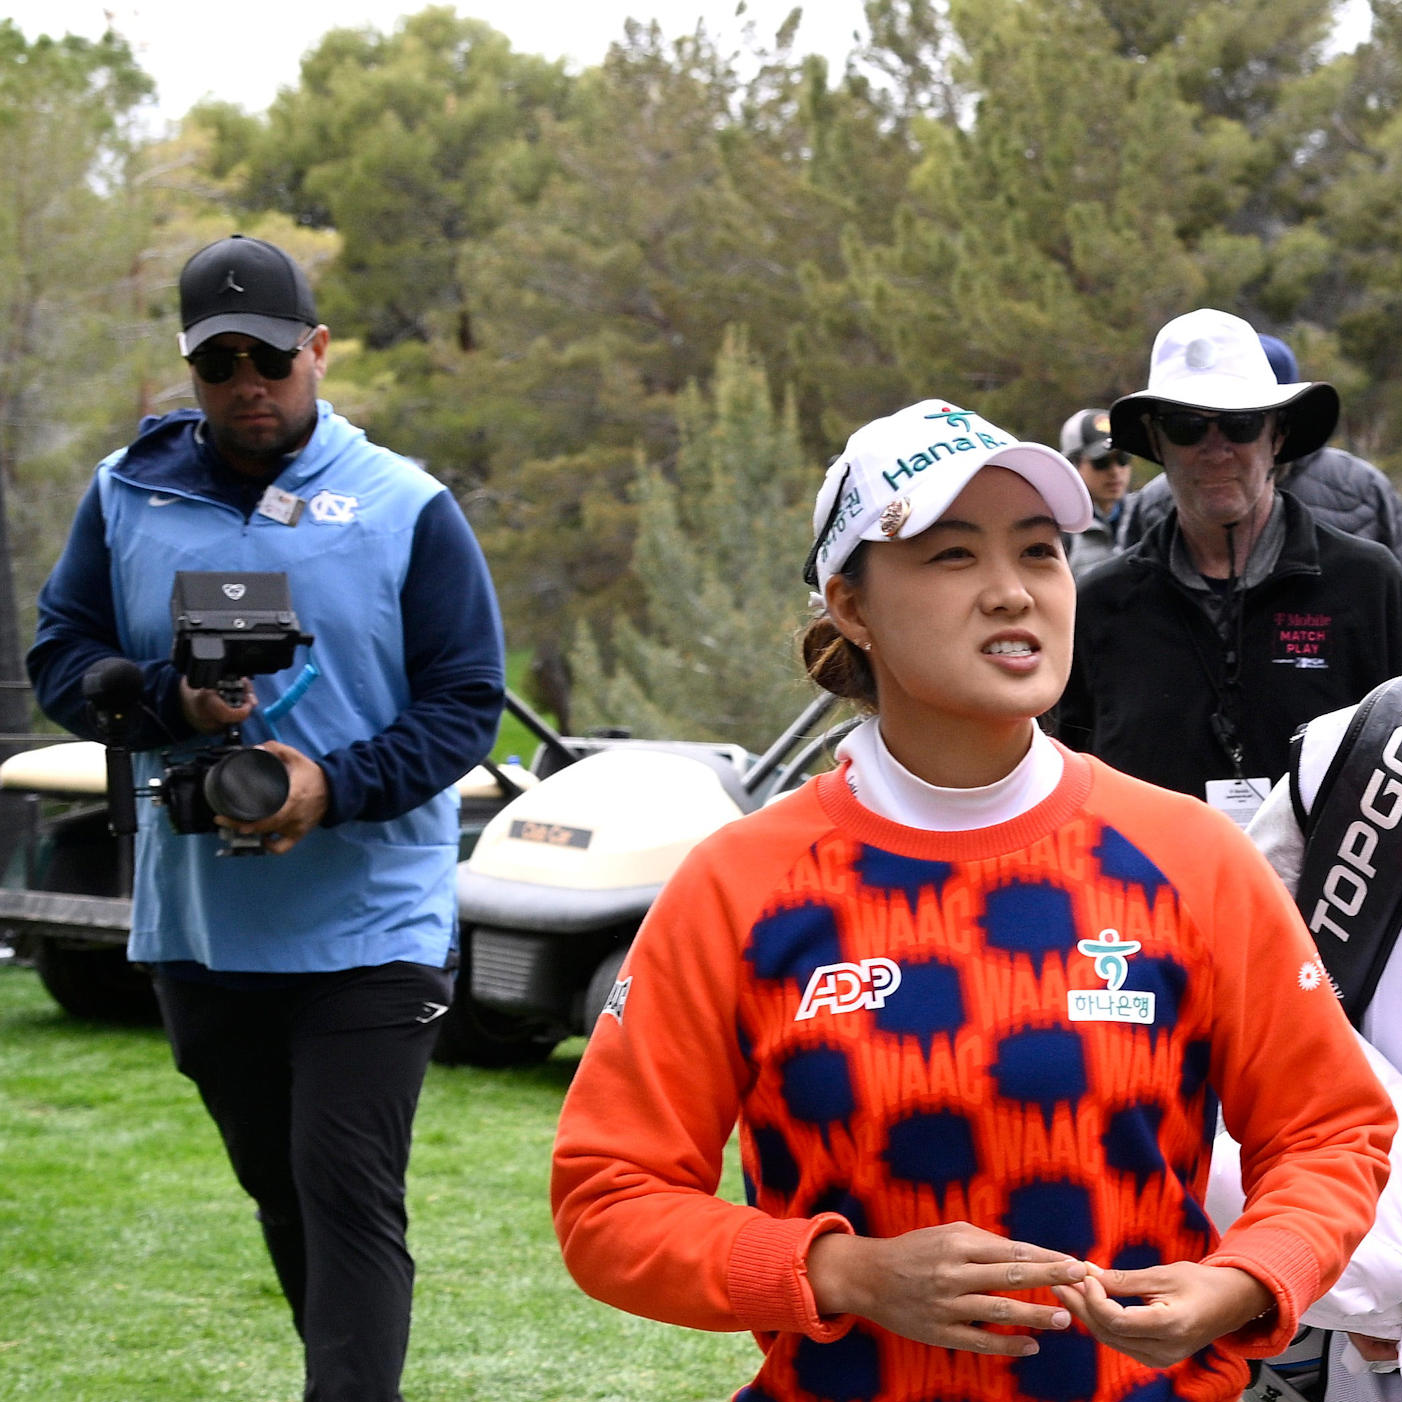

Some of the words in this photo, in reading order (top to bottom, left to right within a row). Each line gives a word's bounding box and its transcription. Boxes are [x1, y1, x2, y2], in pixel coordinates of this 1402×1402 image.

[882, 436, 977, 492] Hana
[1280, 630, 1326, 641] MATCH
[1286, 643, 1319, 654] PLAY
[794, 958, 901, 1021] ADP
[1074, 994, 1150, 1018] 하나은행
